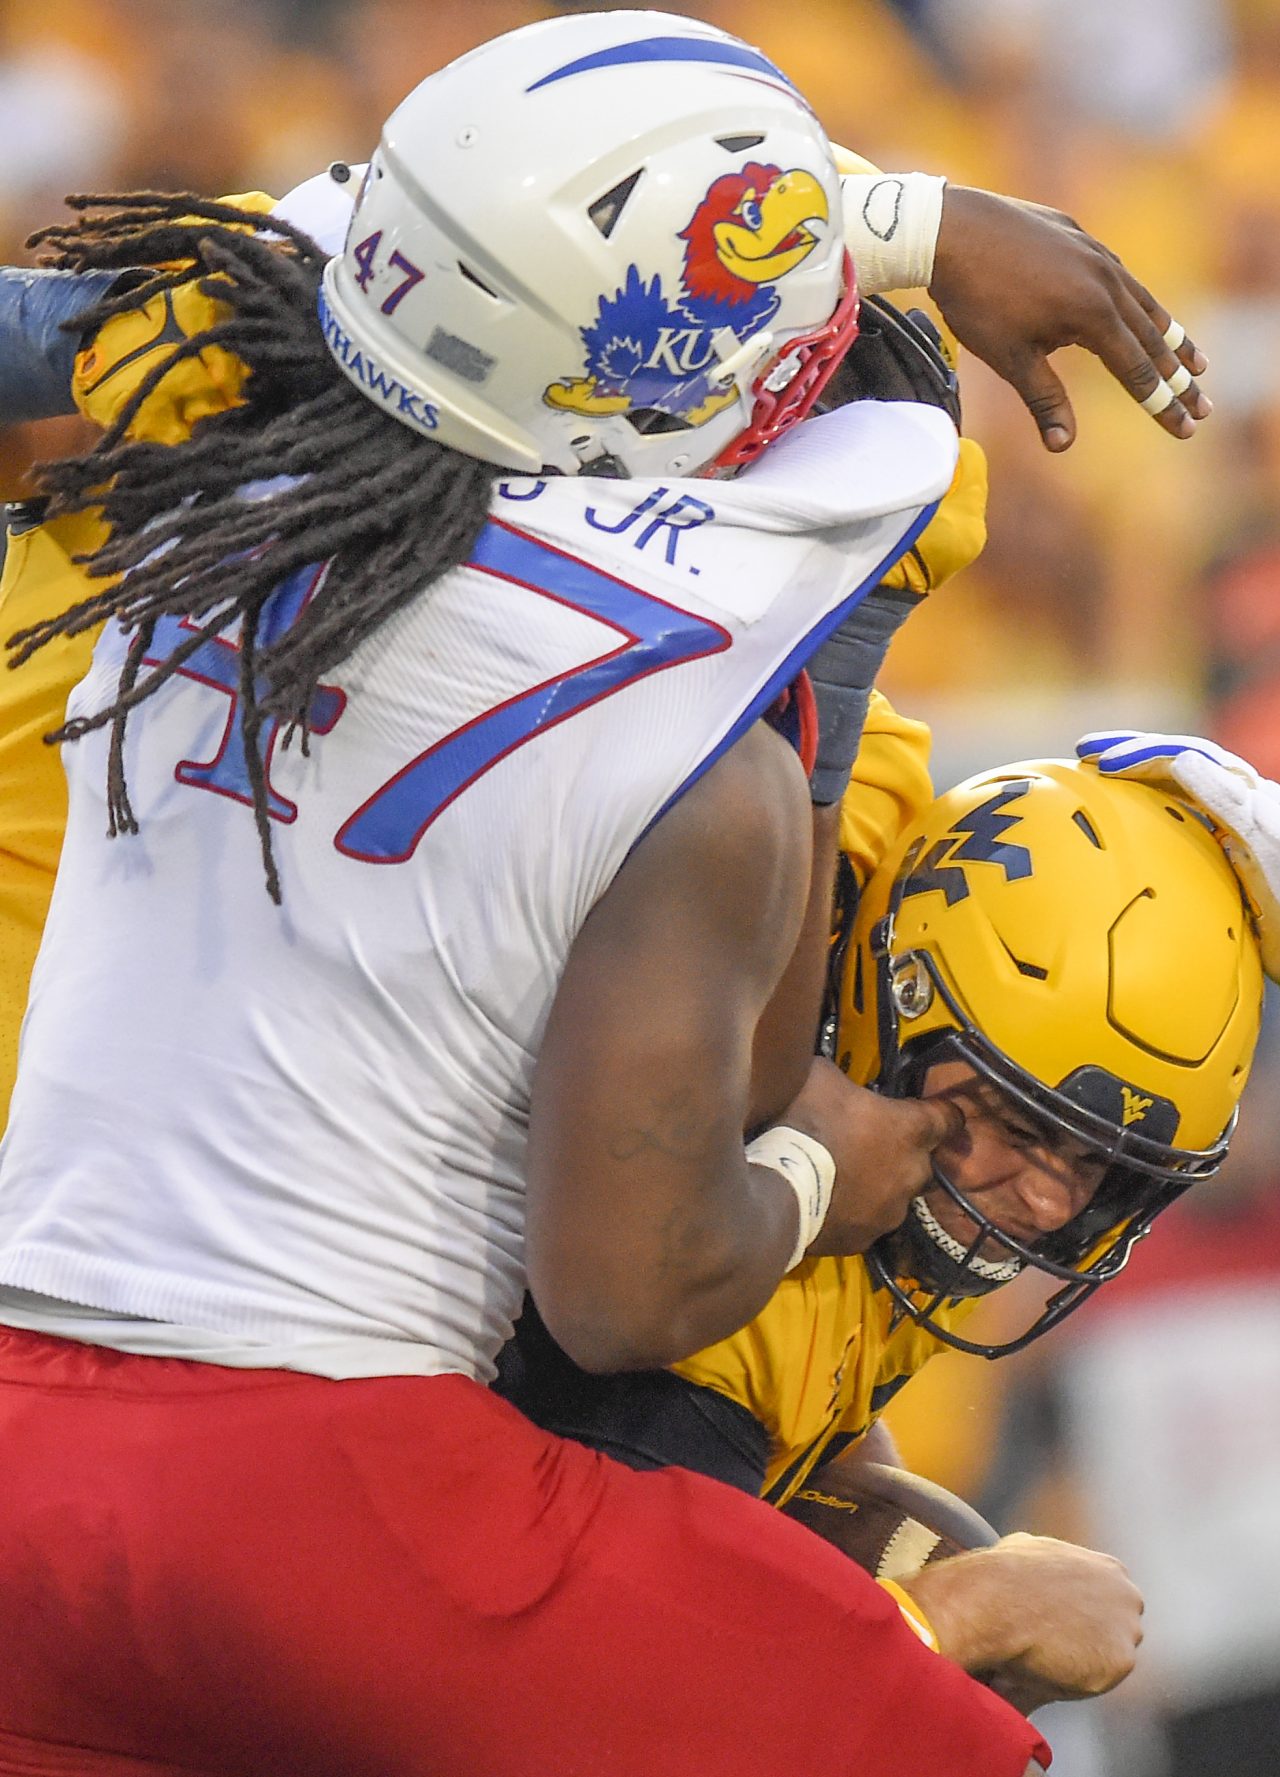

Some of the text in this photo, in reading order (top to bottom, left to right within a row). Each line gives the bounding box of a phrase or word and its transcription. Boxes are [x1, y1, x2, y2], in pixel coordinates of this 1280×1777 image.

[354, 229, 425, 316] 47
[317, 285, 439, 430] YHAWKS
[643, 326, 724, 376] KU
[585, 486, 716, 576] JR.
